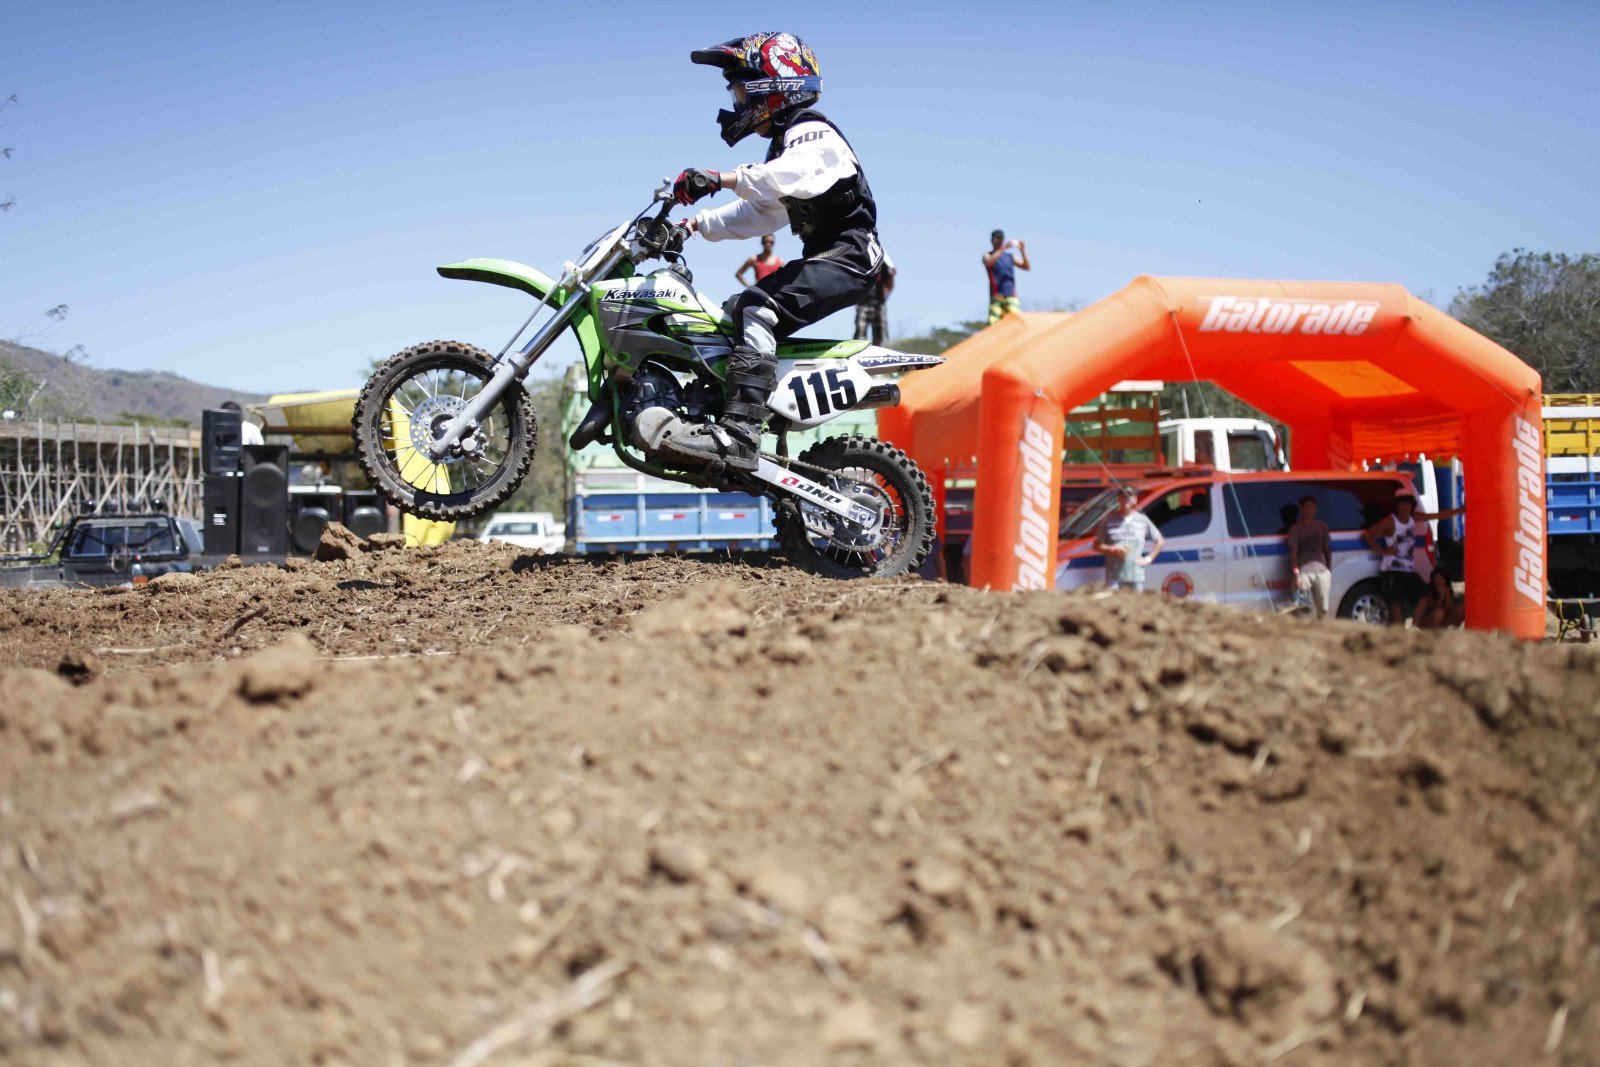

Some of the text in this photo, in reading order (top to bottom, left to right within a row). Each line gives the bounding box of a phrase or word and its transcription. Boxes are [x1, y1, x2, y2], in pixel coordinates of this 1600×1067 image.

[745, 79, 806, 93] SCOTT
[603, 288, 677, 300] Kawasaki
[1199, 296, 1379, 336] Gatorade
[787, 366, 858, 421] 115
[1012, 416, 1054, 592] atorade
[1511, 415, 1543, 607] Gatorade
